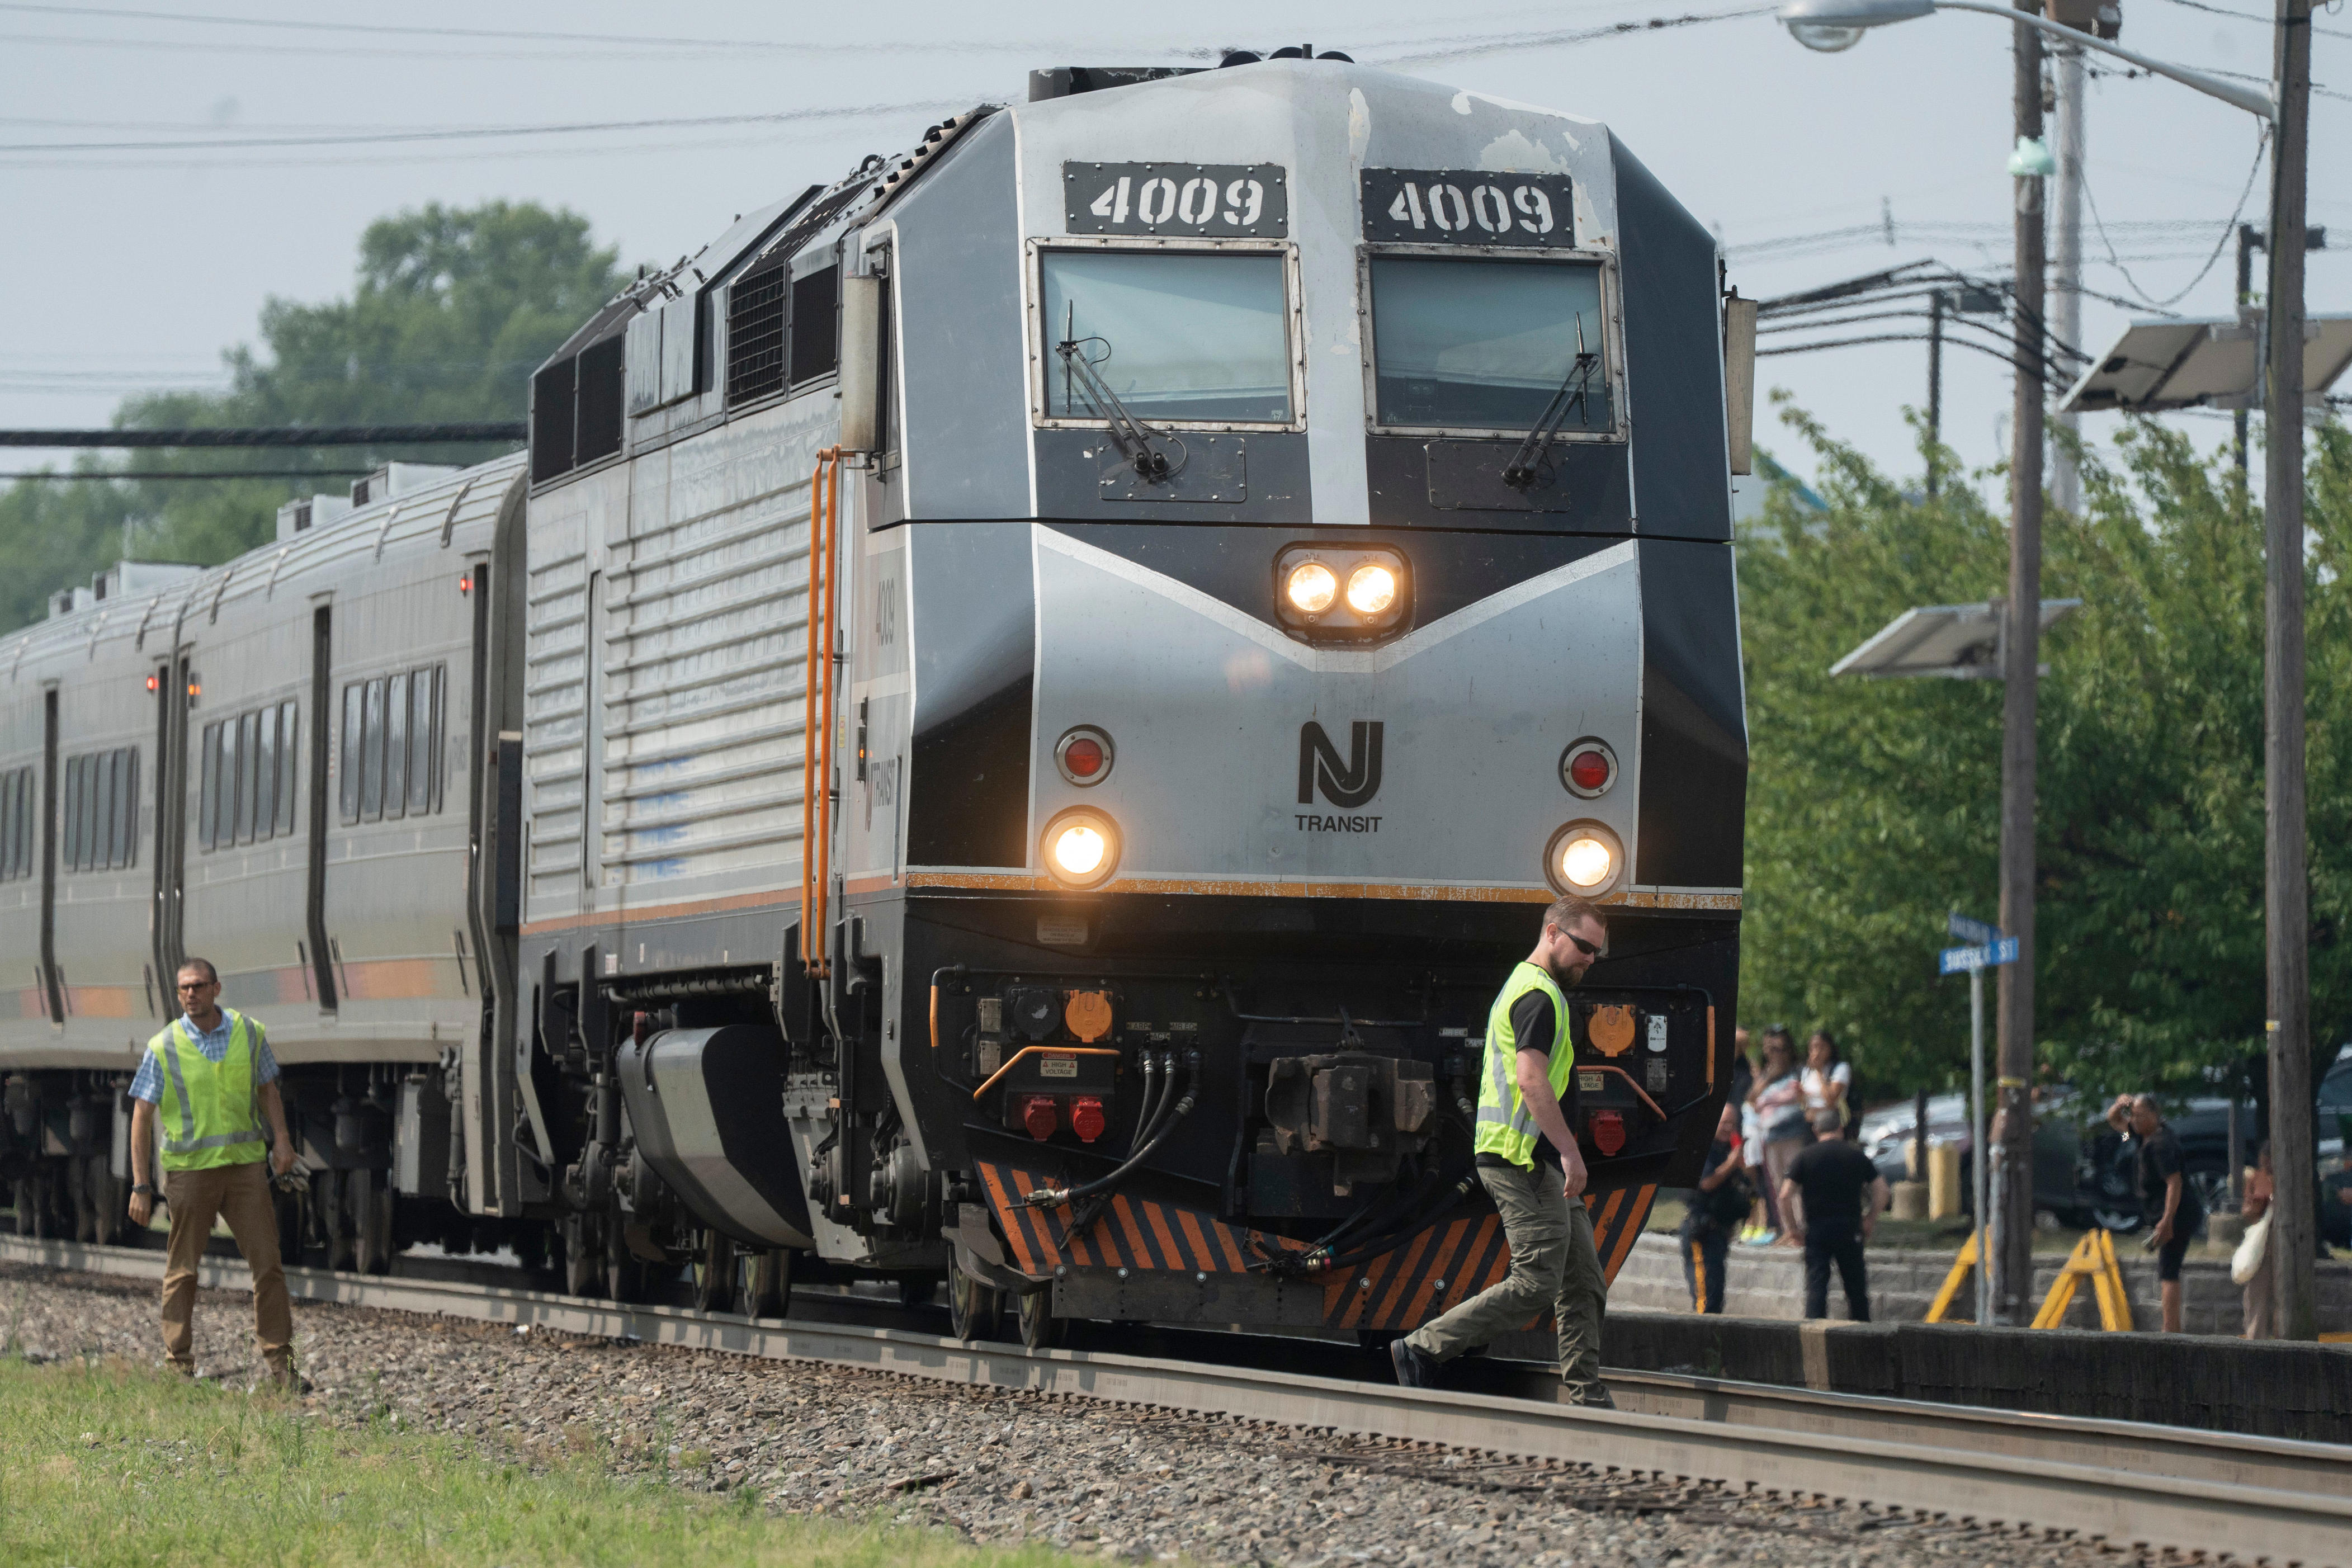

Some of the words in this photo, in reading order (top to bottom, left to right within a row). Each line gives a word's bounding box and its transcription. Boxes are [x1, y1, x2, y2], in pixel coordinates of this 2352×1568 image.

[1090, 177, 1263, 225] 4009
[1387, 182, 1555, 234] 4009
[876, 578, 895, 646] 4009
[873, 759, 895, 807] TRANSIT
[1298, 721, 1384, 809] NJ
[1294, 814, 1383, 833] TRANSIT
